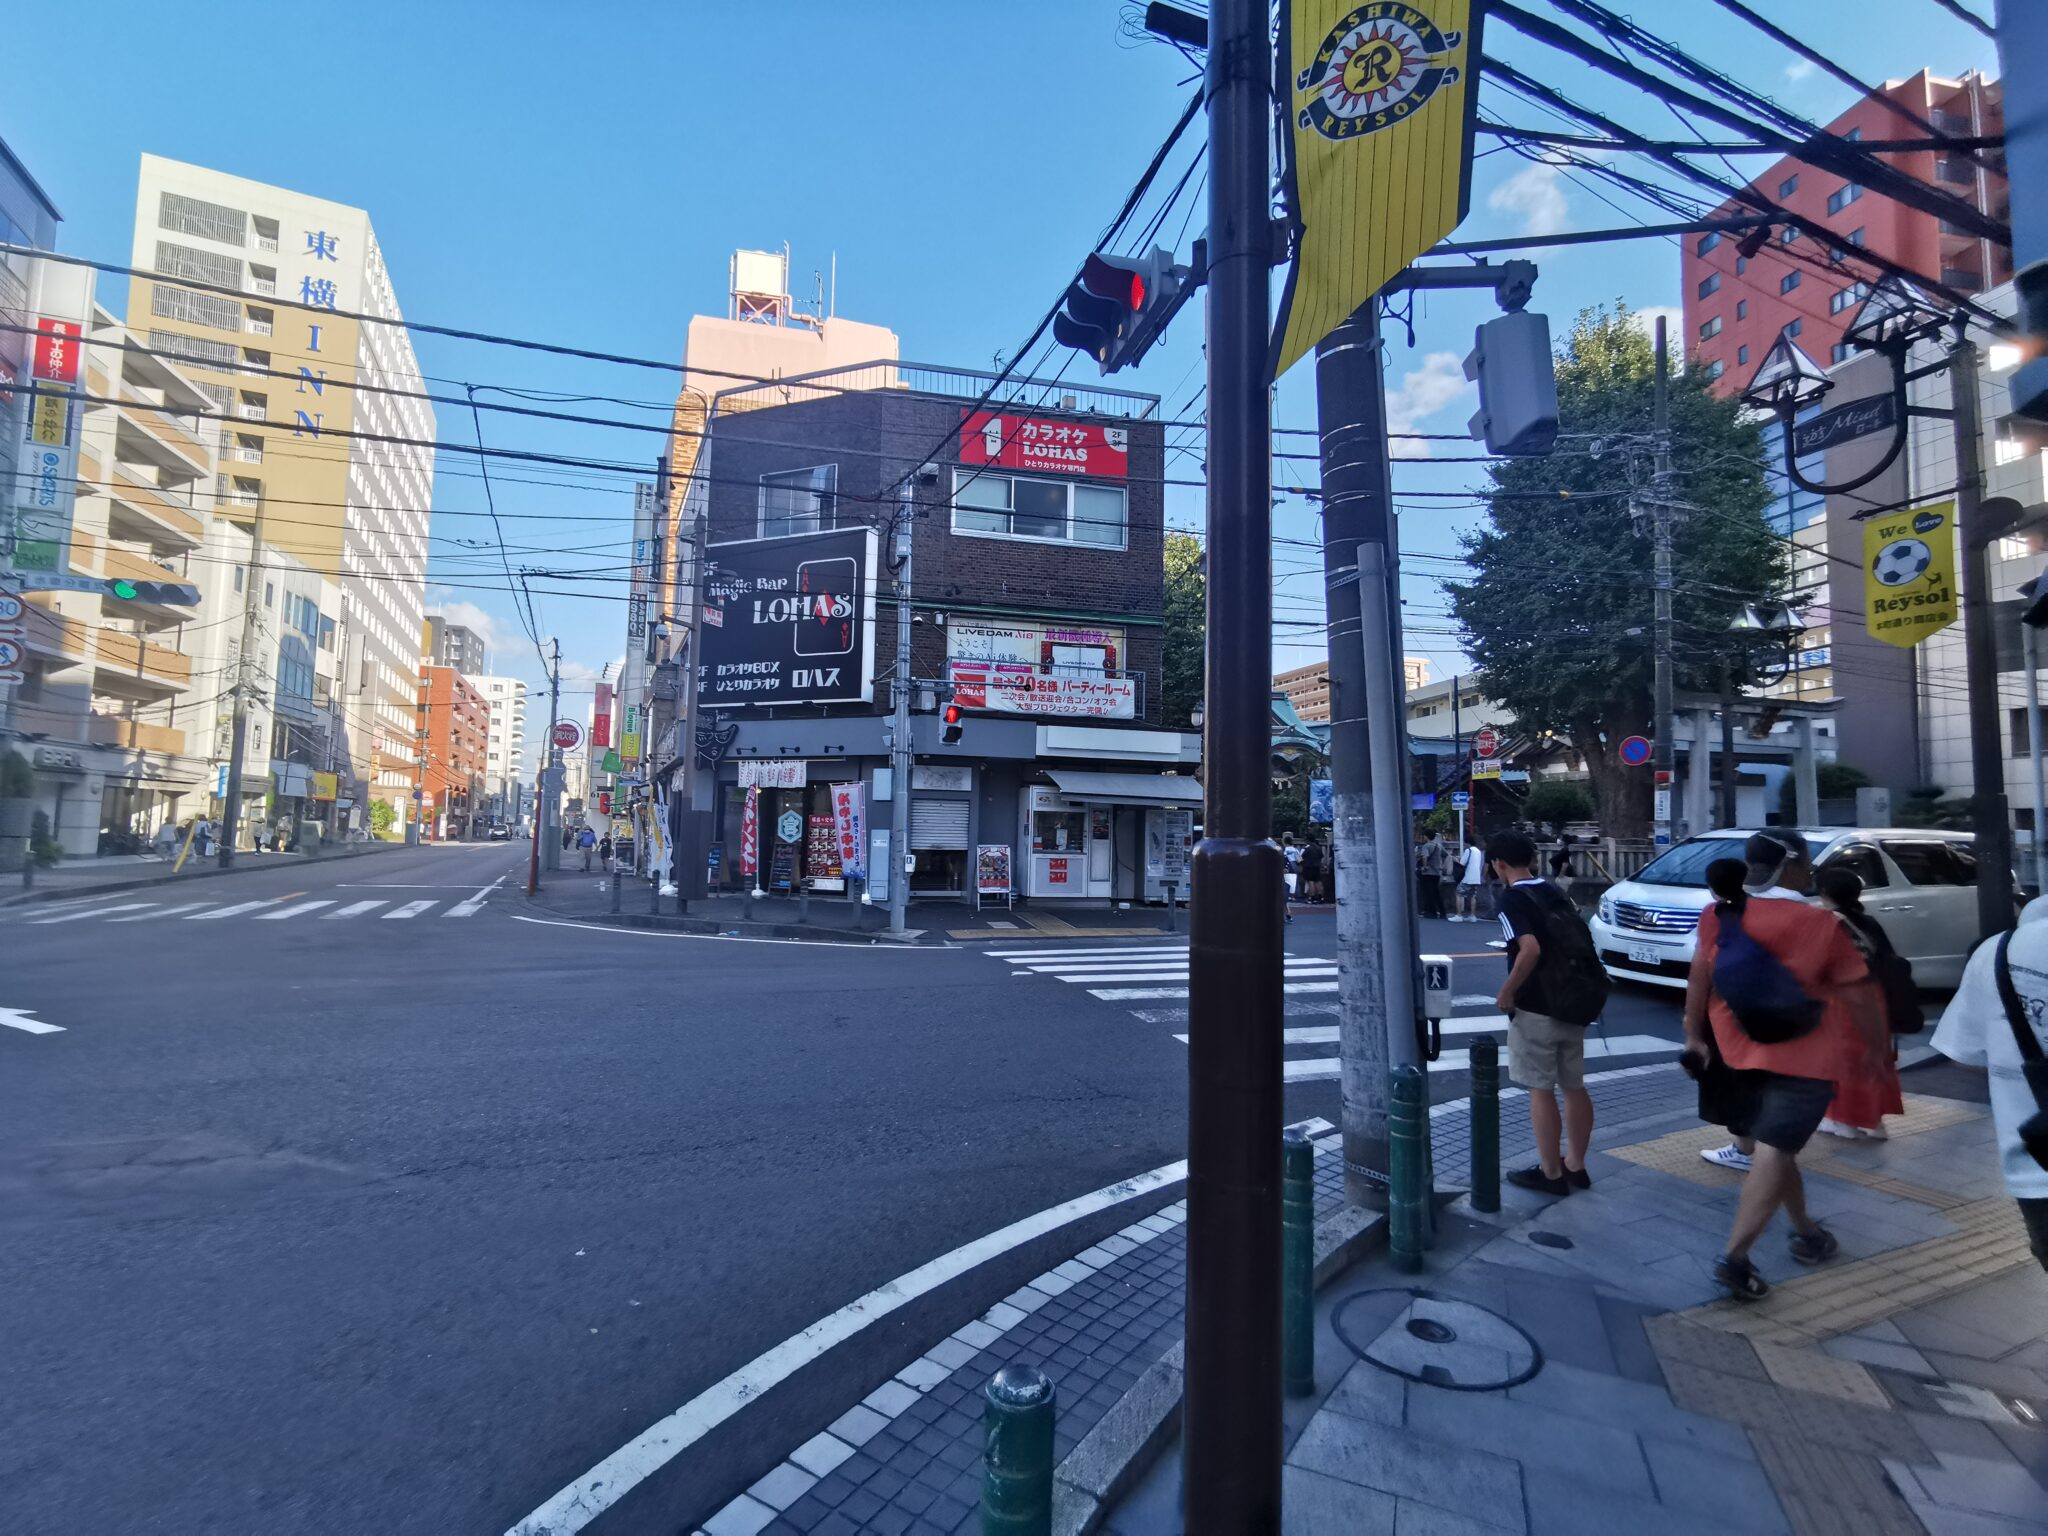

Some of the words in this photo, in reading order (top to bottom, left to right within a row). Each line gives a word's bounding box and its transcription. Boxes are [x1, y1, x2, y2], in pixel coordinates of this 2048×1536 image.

[1319, 5, 1432, 63] KASHIWA
[1321, 91, 1426, 136] REYSOL
[1022, 422, 1088, 445] カラオケ
[1022, 441, 1088, 462] LOHAS
[1024, 459, 1086, 473] ひとりカラオケ専門店
[1878, 525, 1908, 540] We
[757, 577, 788, 593] Bar
[753, 592, 852, 624] LOHAS
[1874, 588, 1950, 614] Reysol
[717, 661, 781, 676] カラオケBOX
[792, 667, 841, 688] ロハス
[717, 678, 781, 692] ひとりカラオケ
[956, 687, 985, 696] LOHAS
[553, 729, 578, 742] 消火栓
